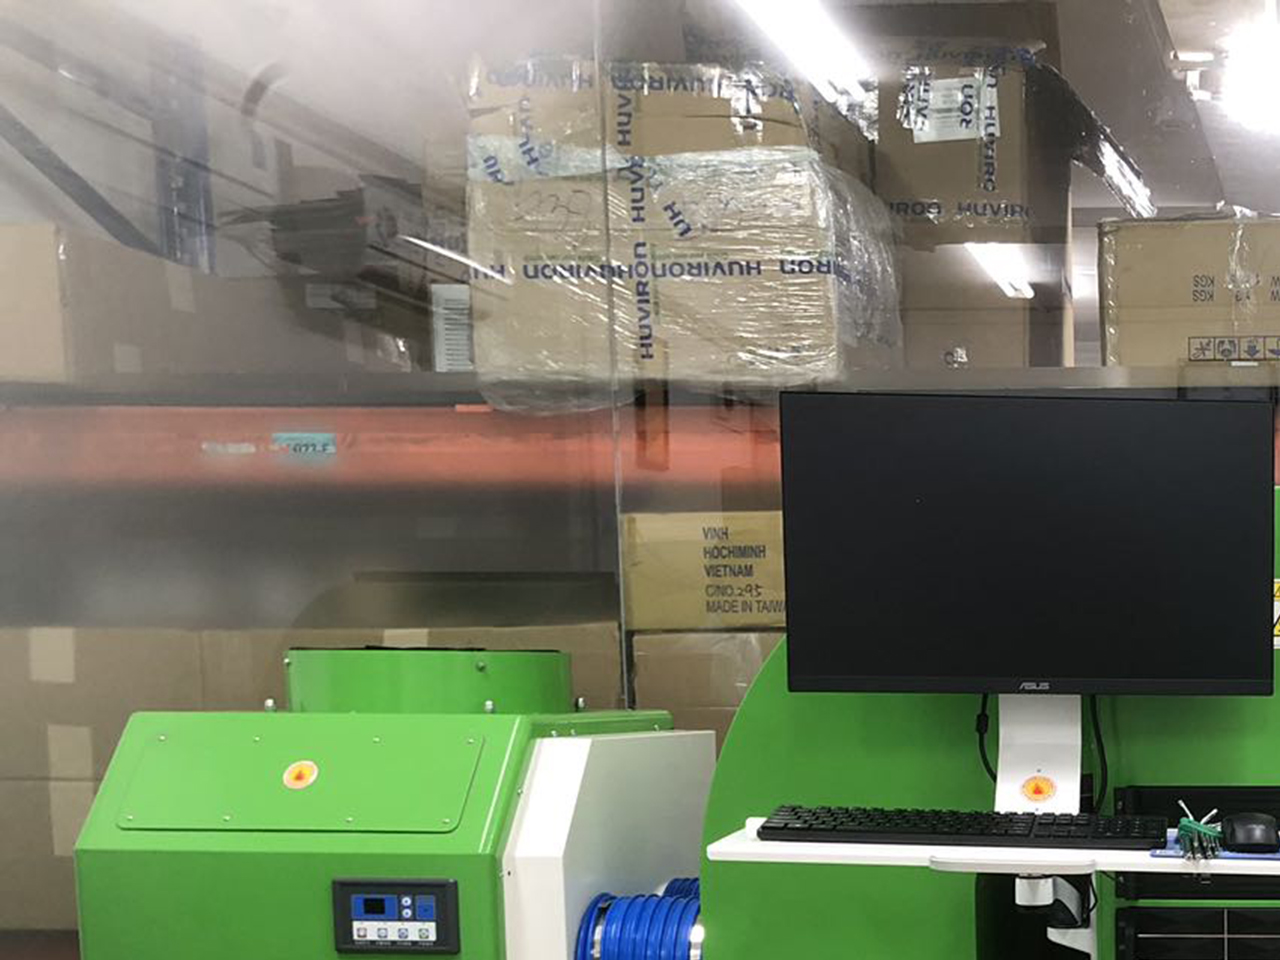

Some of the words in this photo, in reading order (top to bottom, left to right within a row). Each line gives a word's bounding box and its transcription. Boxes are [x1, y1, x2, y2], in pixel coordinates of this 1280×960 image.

[703, 545, 766, 559] HOCHIMINH
[704, 564, 754, 578] VIETNAM
[706, 600, 739, 614] MADE
[741, 600, 753, 614] IN
[1019, 682, 1050, 690] ASUS
